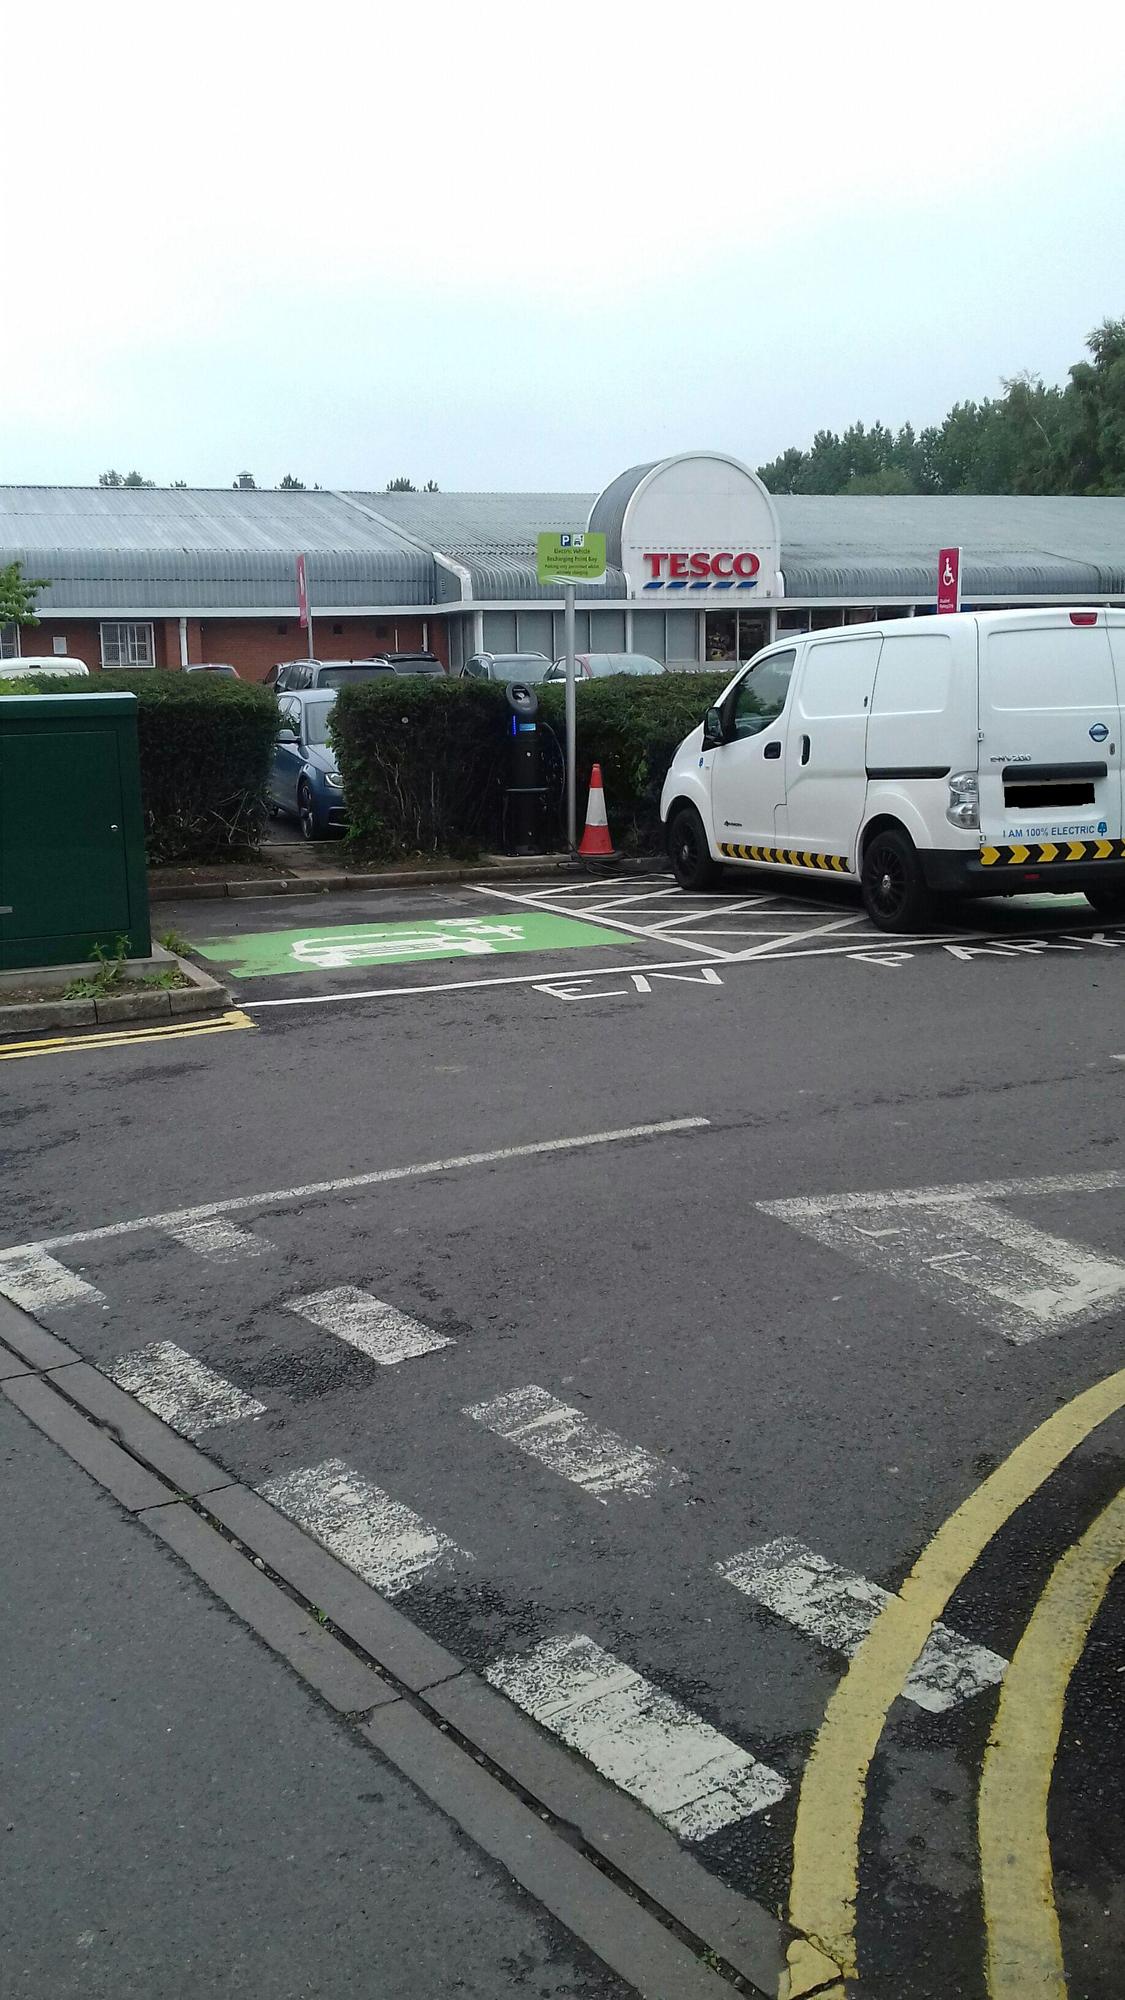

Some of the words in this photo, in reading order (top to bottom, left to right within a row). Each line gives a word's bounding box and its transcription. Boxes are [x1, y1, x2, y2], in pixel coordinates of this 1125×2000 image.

[562, 535, 570, 546] P
[642, 552, 761, 578] TESCO
[1008, 829, 1023, 838] AM
[1026, 827, 1049, 837] 100%
[1051, 825, 1095, 836] ELECTRIC
[846, 930, 1125, 967] PARK
